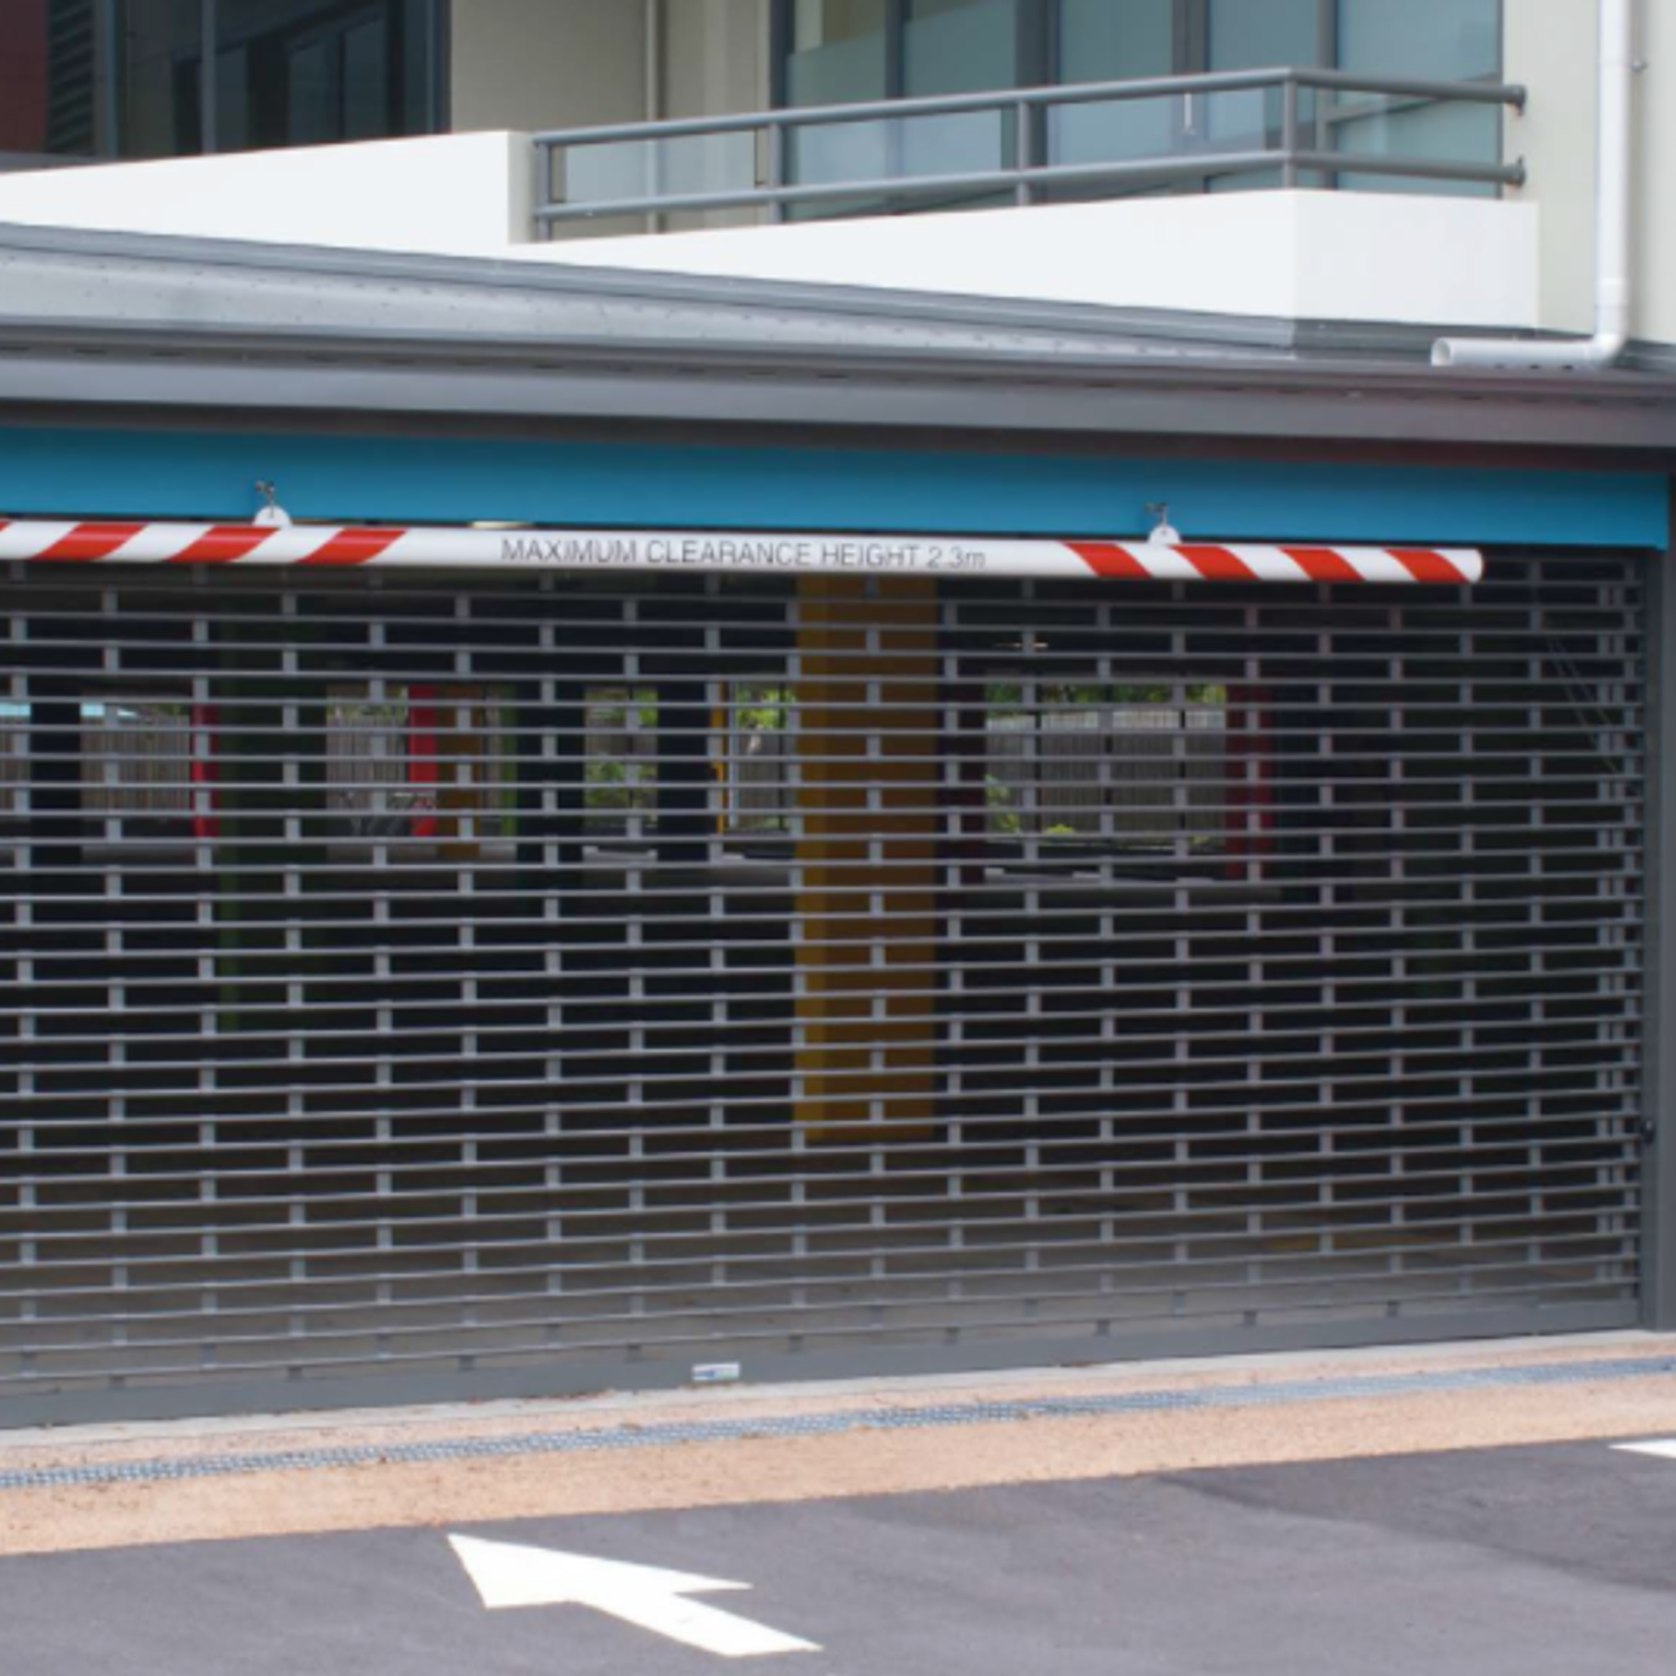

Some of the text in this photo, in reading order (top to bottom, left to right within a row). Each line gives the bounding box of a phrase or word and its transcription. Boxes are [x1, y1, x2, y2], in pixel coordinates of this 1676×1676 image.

[501, 538, 637, 563] MAXIMUM
[646, 540, 812, 566] CLEARANCE
[822, 543, 920, 567] HEIGHT
